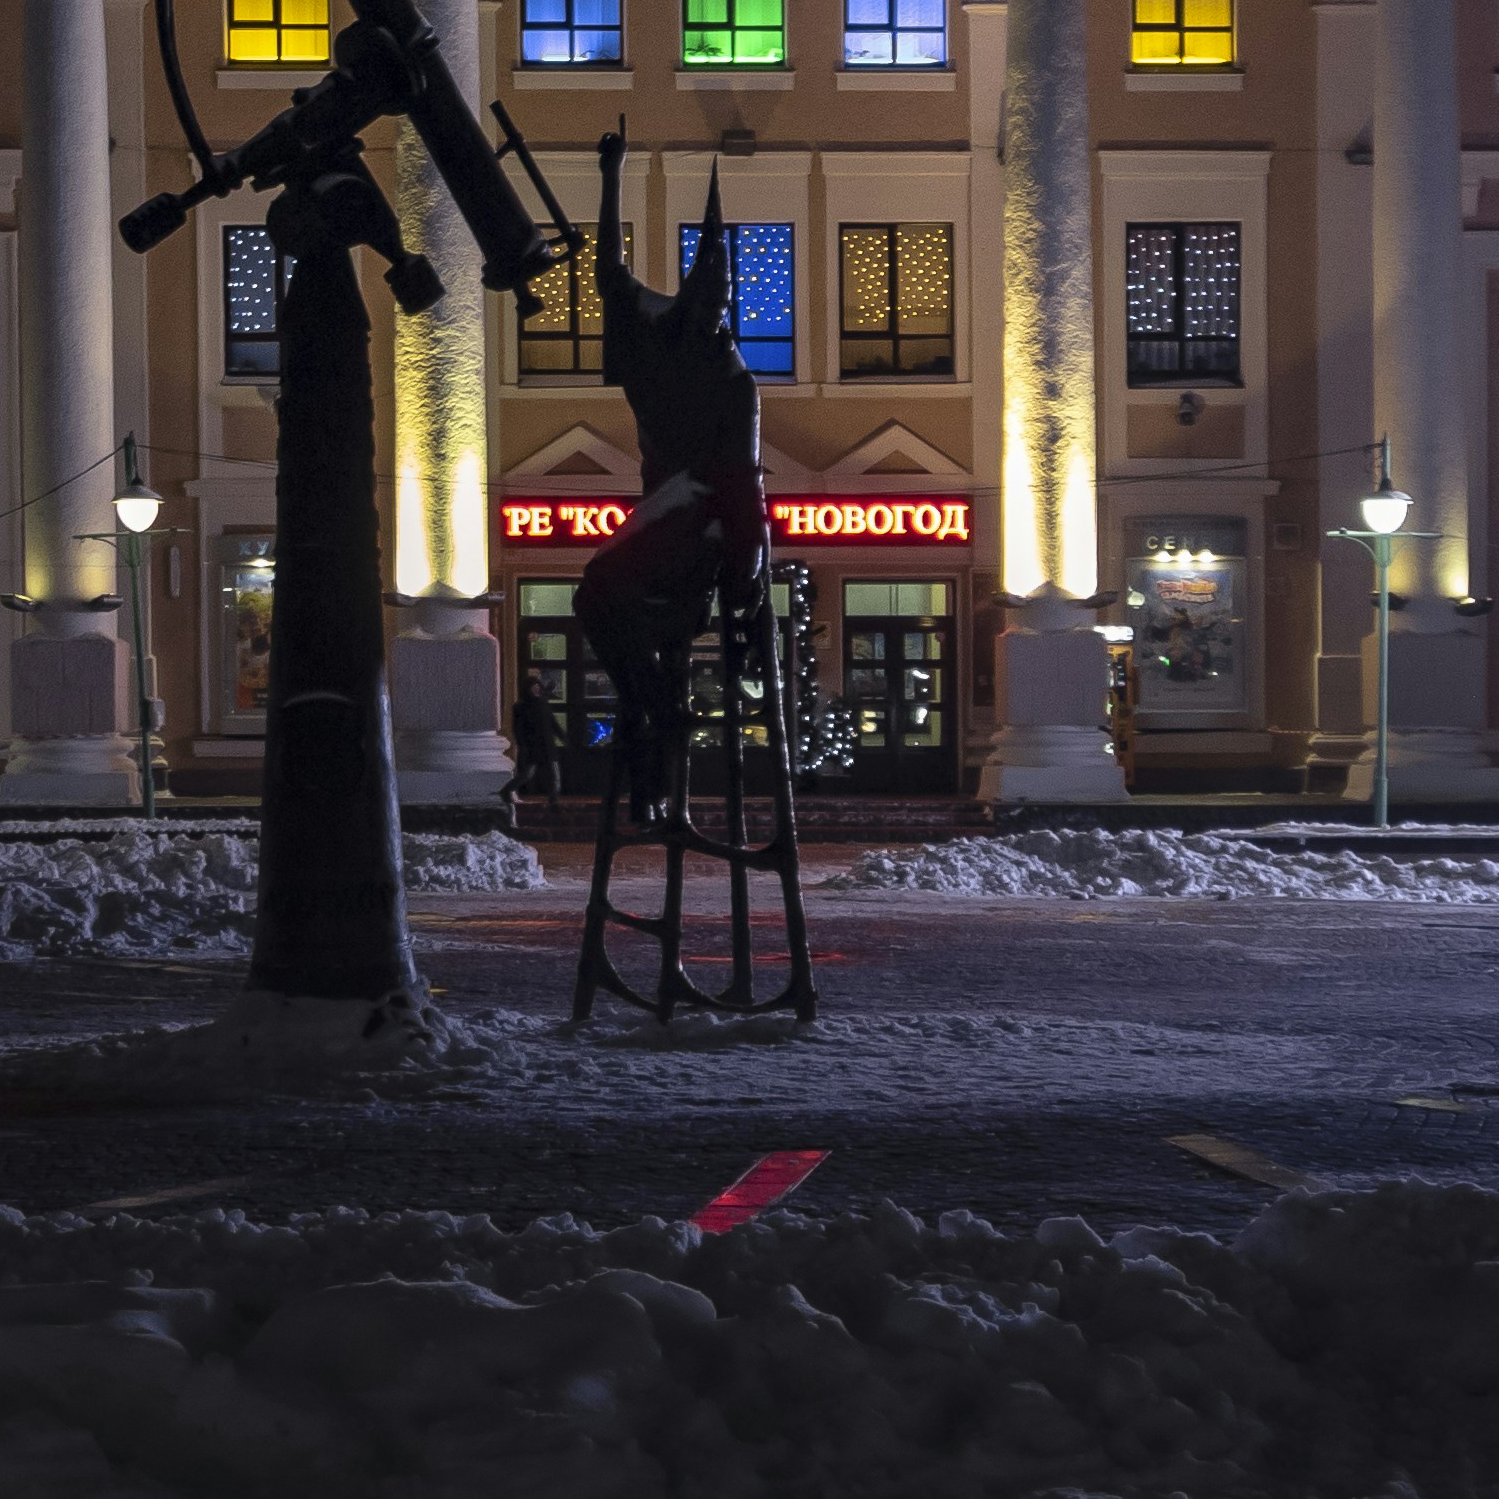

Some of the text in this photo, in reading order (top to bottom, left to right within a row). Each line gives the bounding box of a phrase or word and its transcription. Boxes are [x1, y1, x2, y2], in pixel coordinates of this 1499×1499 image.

[502, 504, 970, 541] РЕ "КО "НОВОГОД
